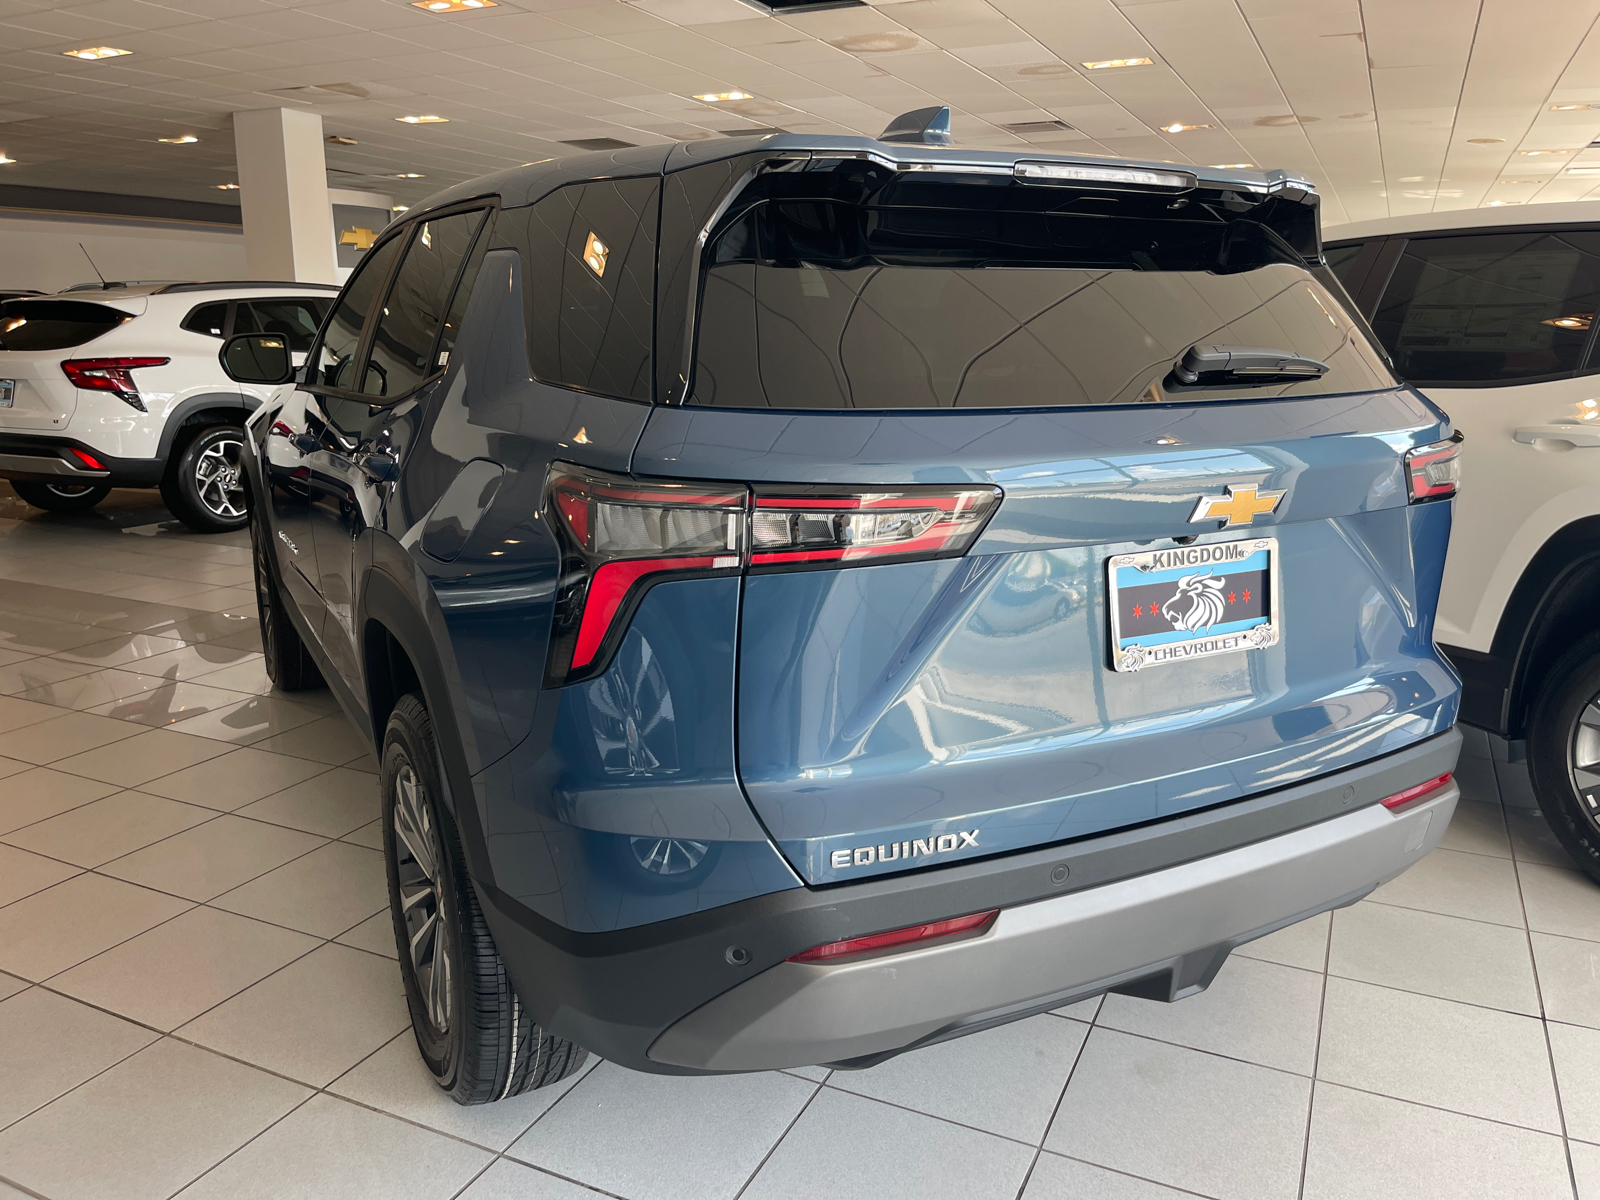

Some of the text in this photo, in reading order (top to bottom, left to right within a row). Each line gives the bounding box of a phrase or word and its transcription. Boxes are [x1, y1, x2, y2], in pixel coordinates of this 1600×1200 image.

[1153, 544, 1238, 568] KINGDOM
[1154, 636, 1240, 661] CHEVROLET
[830, 829, 980, 869] EQUINOX
